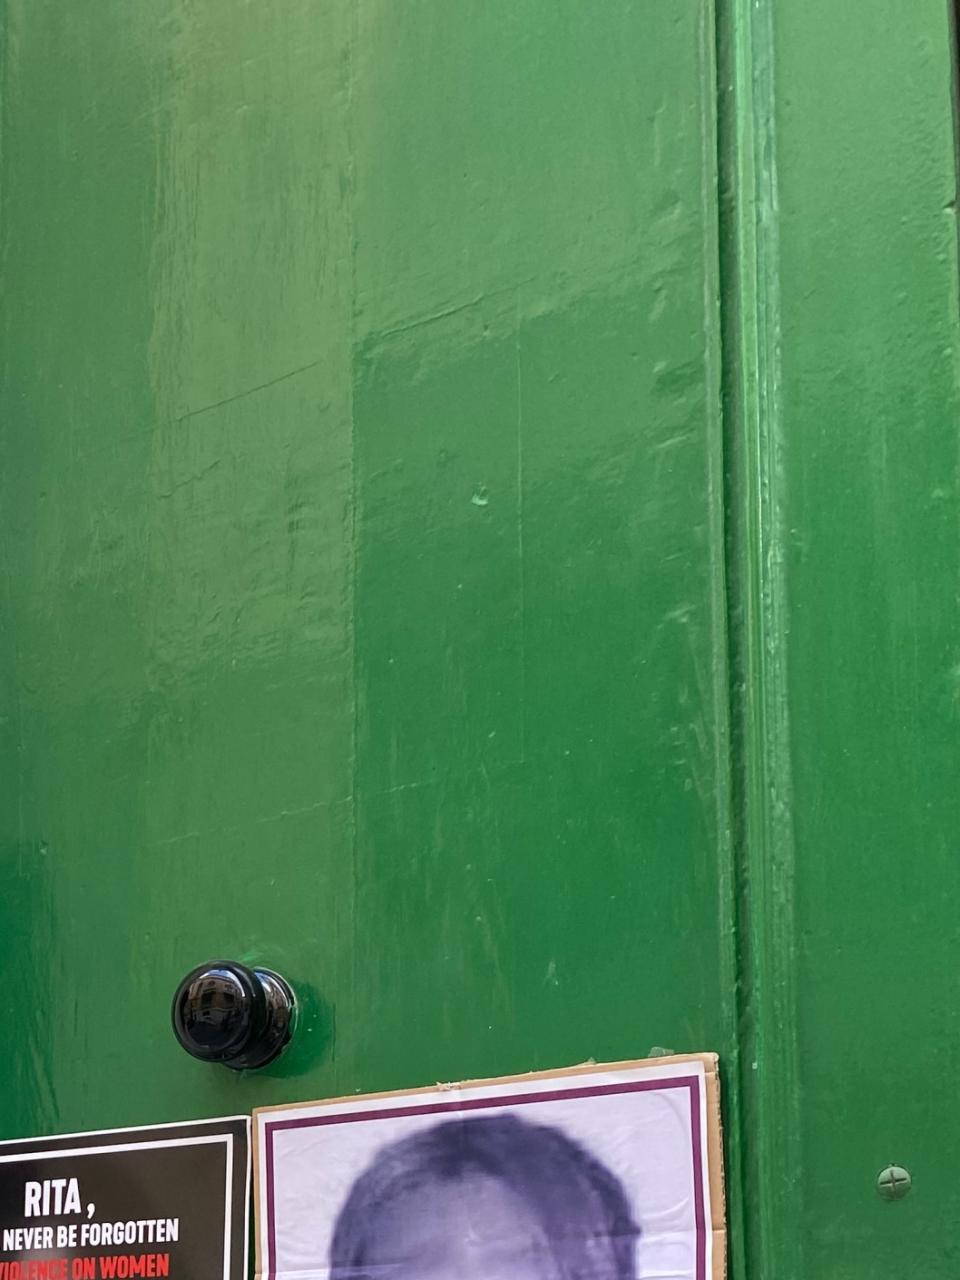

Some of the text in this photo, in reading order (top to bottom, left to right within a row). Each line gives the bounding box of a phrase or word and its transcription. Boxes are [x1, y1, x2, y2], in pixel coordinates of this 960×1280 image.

[3, 1226, 53, 1251] NEVER
[57, 1225, 77, 1248] BE
[81, 1218, 179, 1246] FORGOTTEN
[72, 1257, 95, 1280] ON
[99, 1253, 170, 1279] WOMEN
